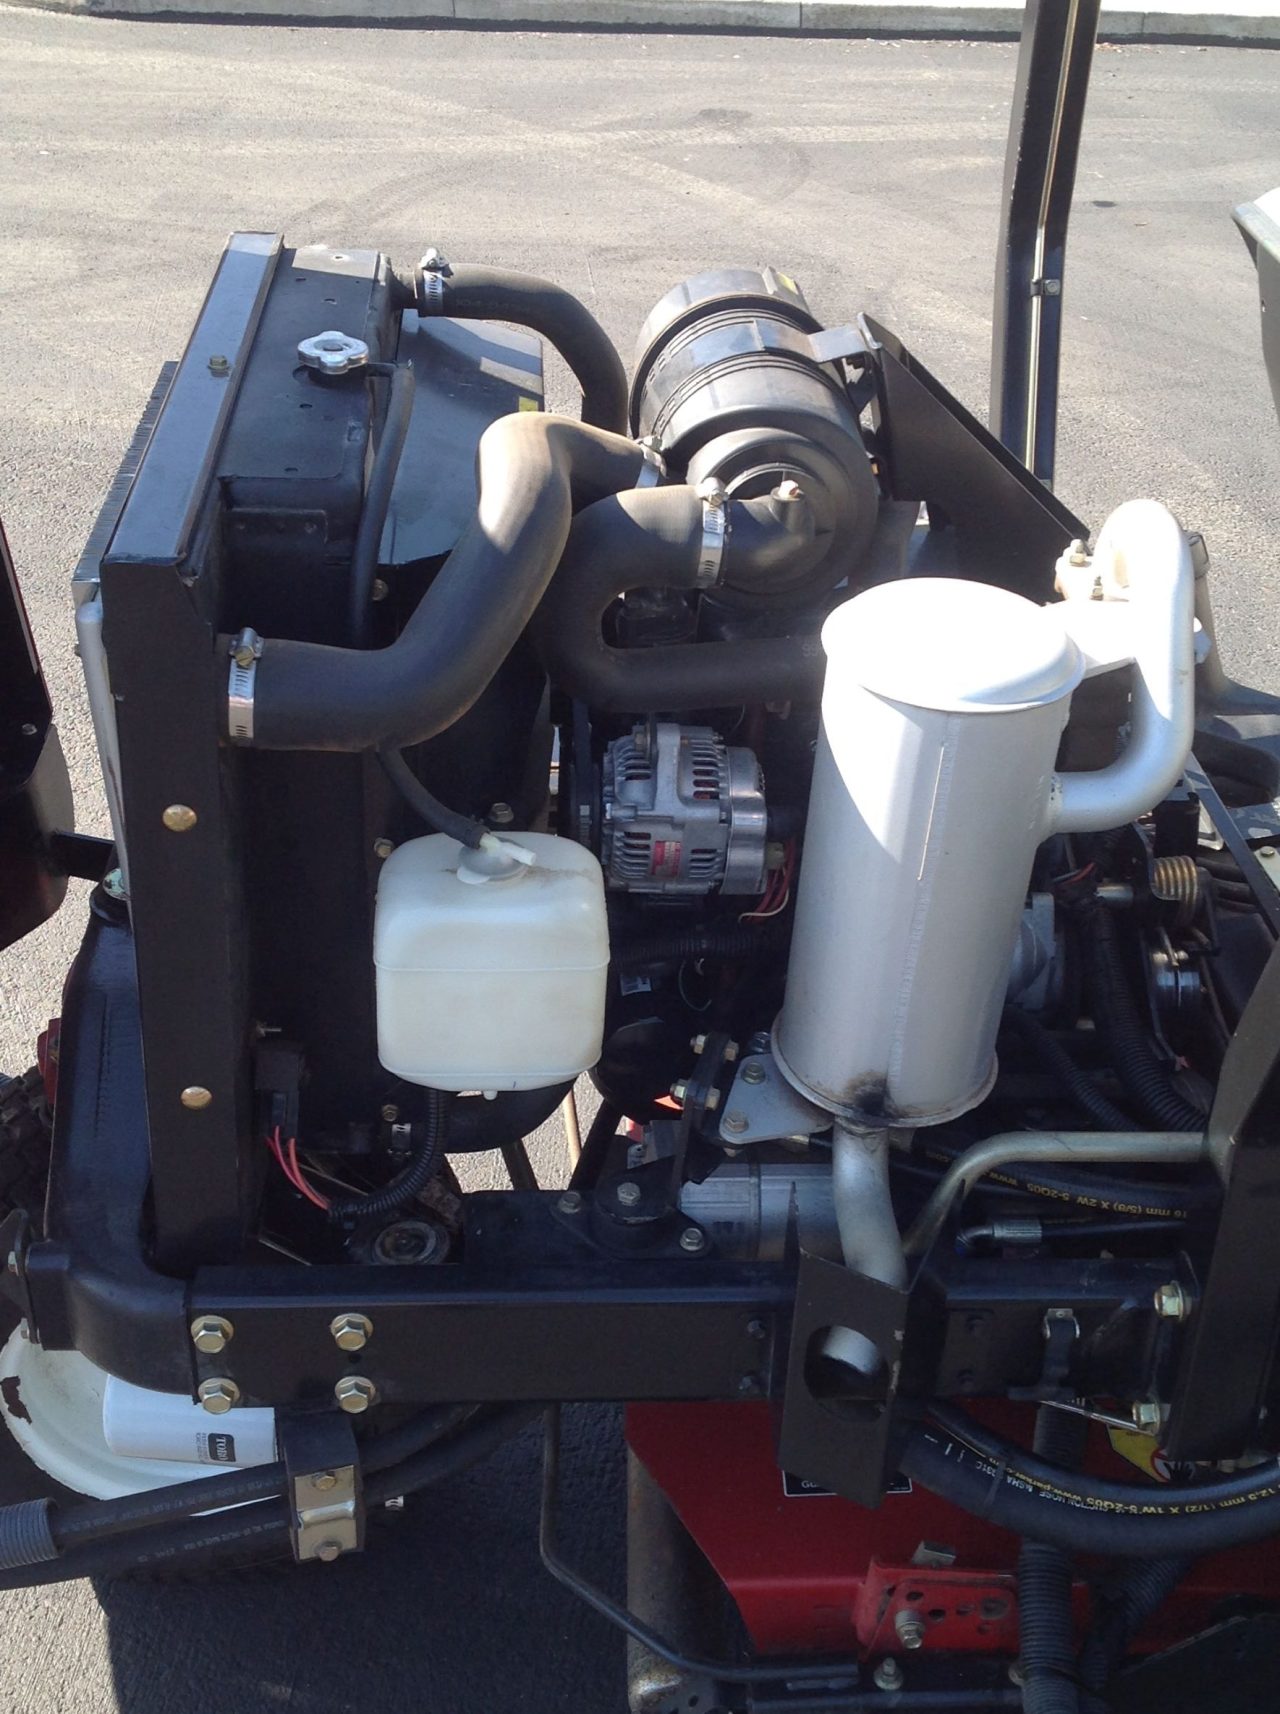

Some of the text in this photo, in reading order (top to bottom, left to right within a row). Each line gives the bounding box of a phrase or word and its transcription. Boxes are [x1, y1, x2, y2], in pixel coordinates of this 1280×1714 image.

[1076, 1195, 1097, 1207] 2W
[1112, 1201, 1142, 1215] (5/8)
[1145, 1207, 1171, 1217] mm
[216, 1437, 228, 1460] TORO
[1219, 1496, 1246, 1509] mm
[1141, 1506, 1165, 1515] 1W
